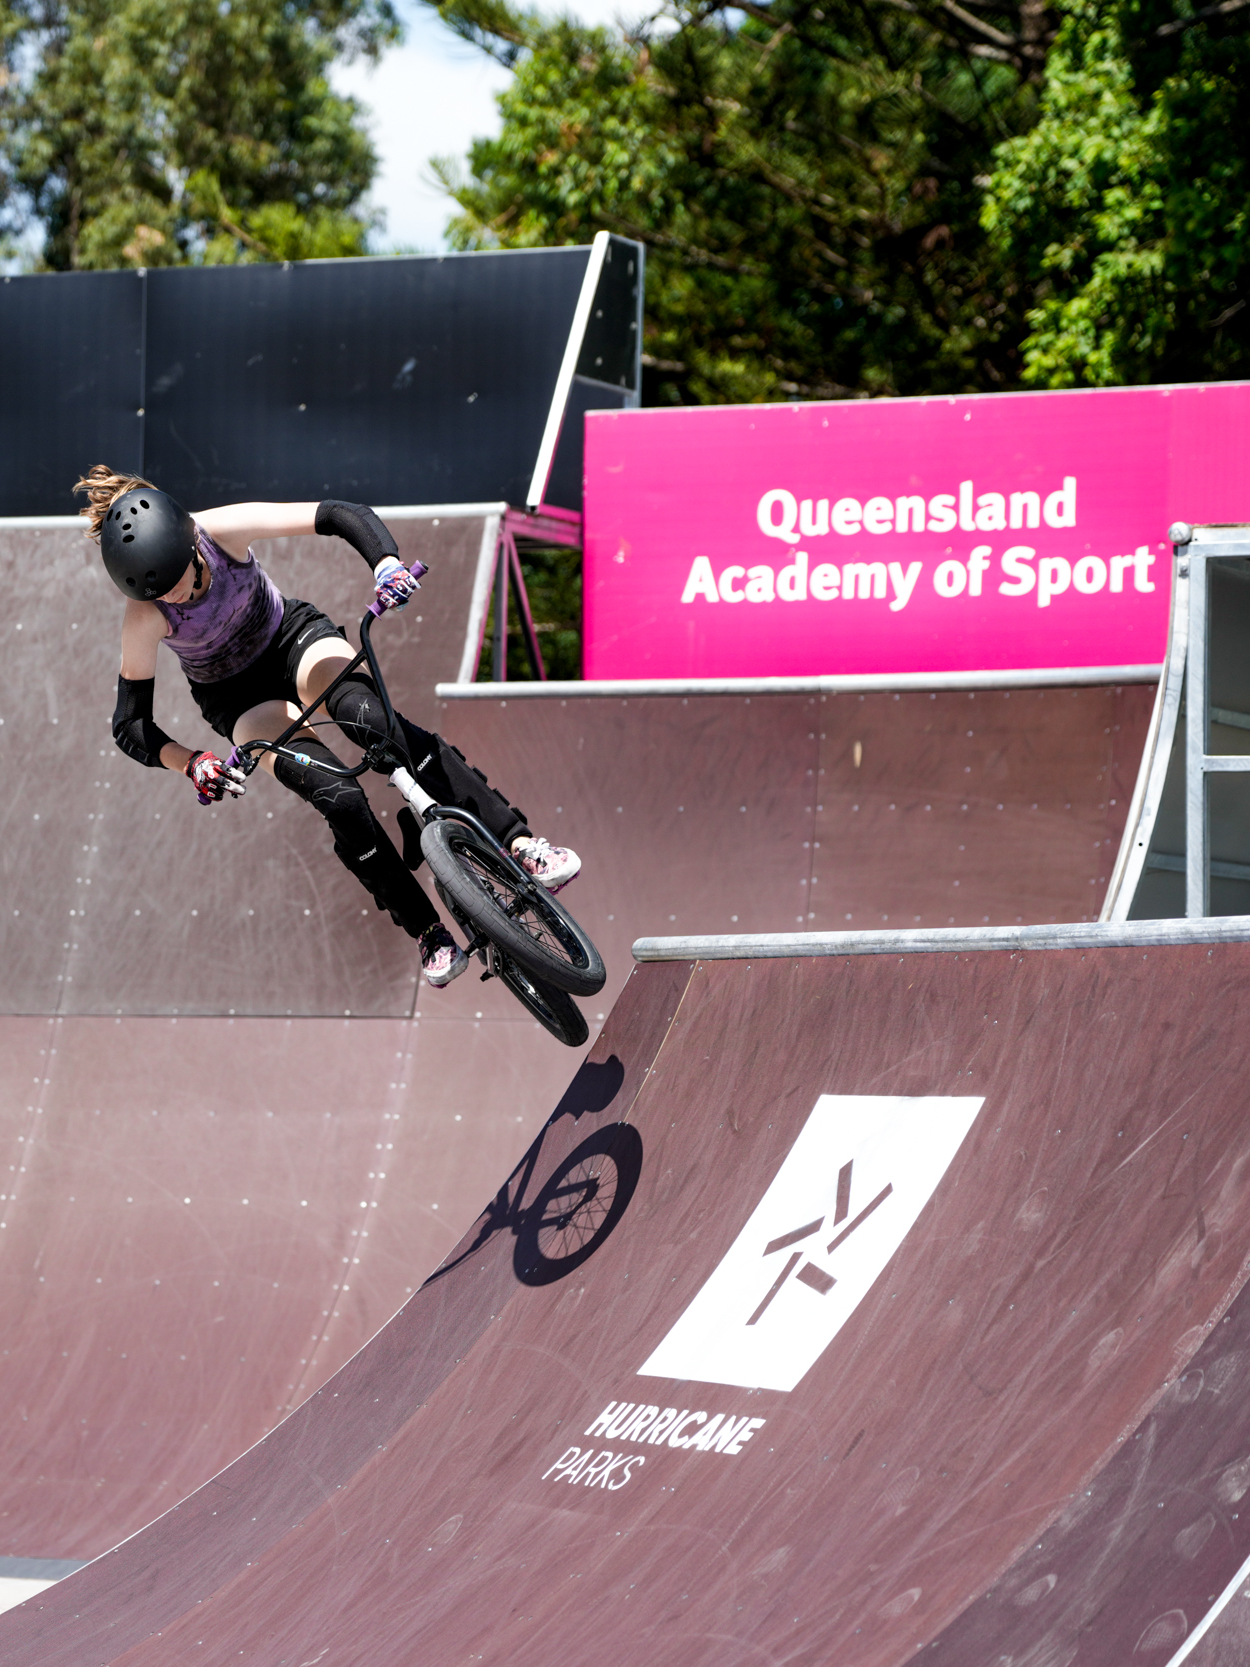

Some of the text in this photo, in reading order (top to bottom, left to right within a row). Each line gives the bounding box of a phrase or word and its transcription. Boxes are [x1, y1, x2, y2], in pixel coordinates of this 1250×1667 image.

[757, 476, 1077, 544] Queensland
[681, 545, 1156, 612] Academy of Sport
[584, 1401, 766, 1455] HURRICANE
[541, 1447, 645, 1490] PARKS
